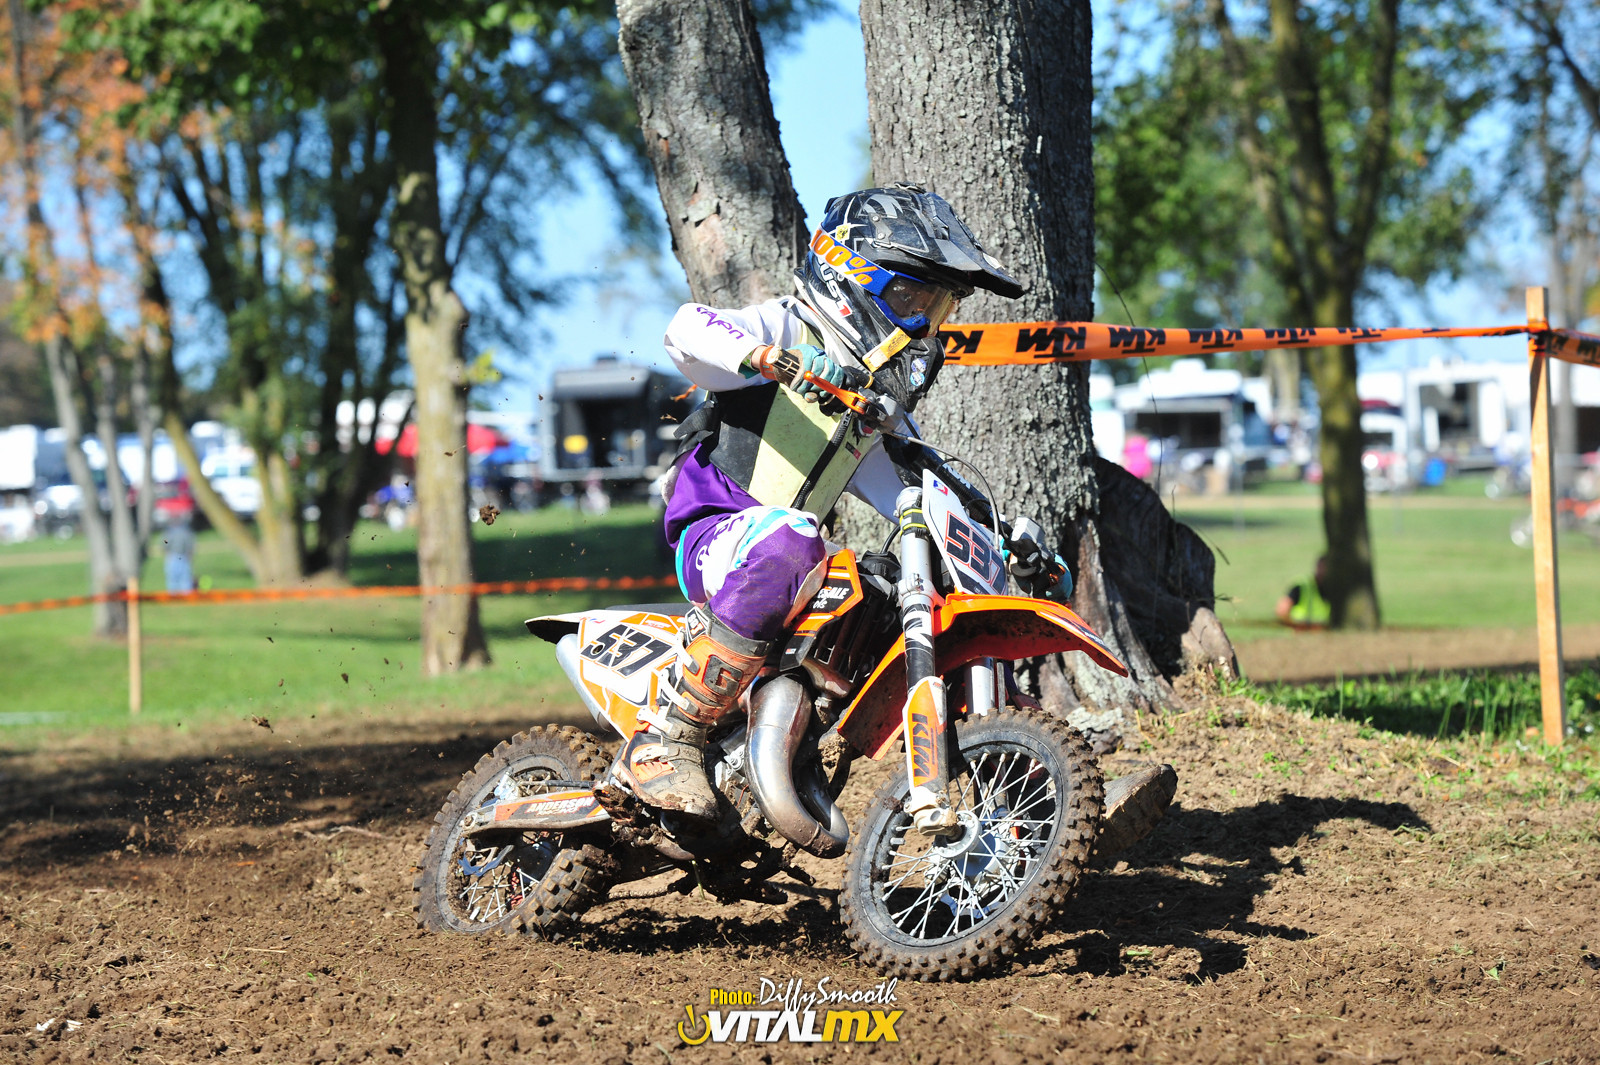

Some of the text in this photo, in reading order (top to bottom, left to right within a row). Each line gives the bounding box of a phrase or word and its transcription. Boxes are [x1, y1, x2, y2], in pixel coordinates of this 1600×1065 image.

[810, 229, 879, 285] 100%
[1015, 326, 1086, 359] KTM
[1108, 327, 1166, 355] KTM
[1189, 328, 1243, 349] KTM
[945, 511, 1006, 596] 537
[580, 623, 672, 677] 537
[911, 713, 931, 777] KTM
[526, 796, 596, 813] ANDERSON
